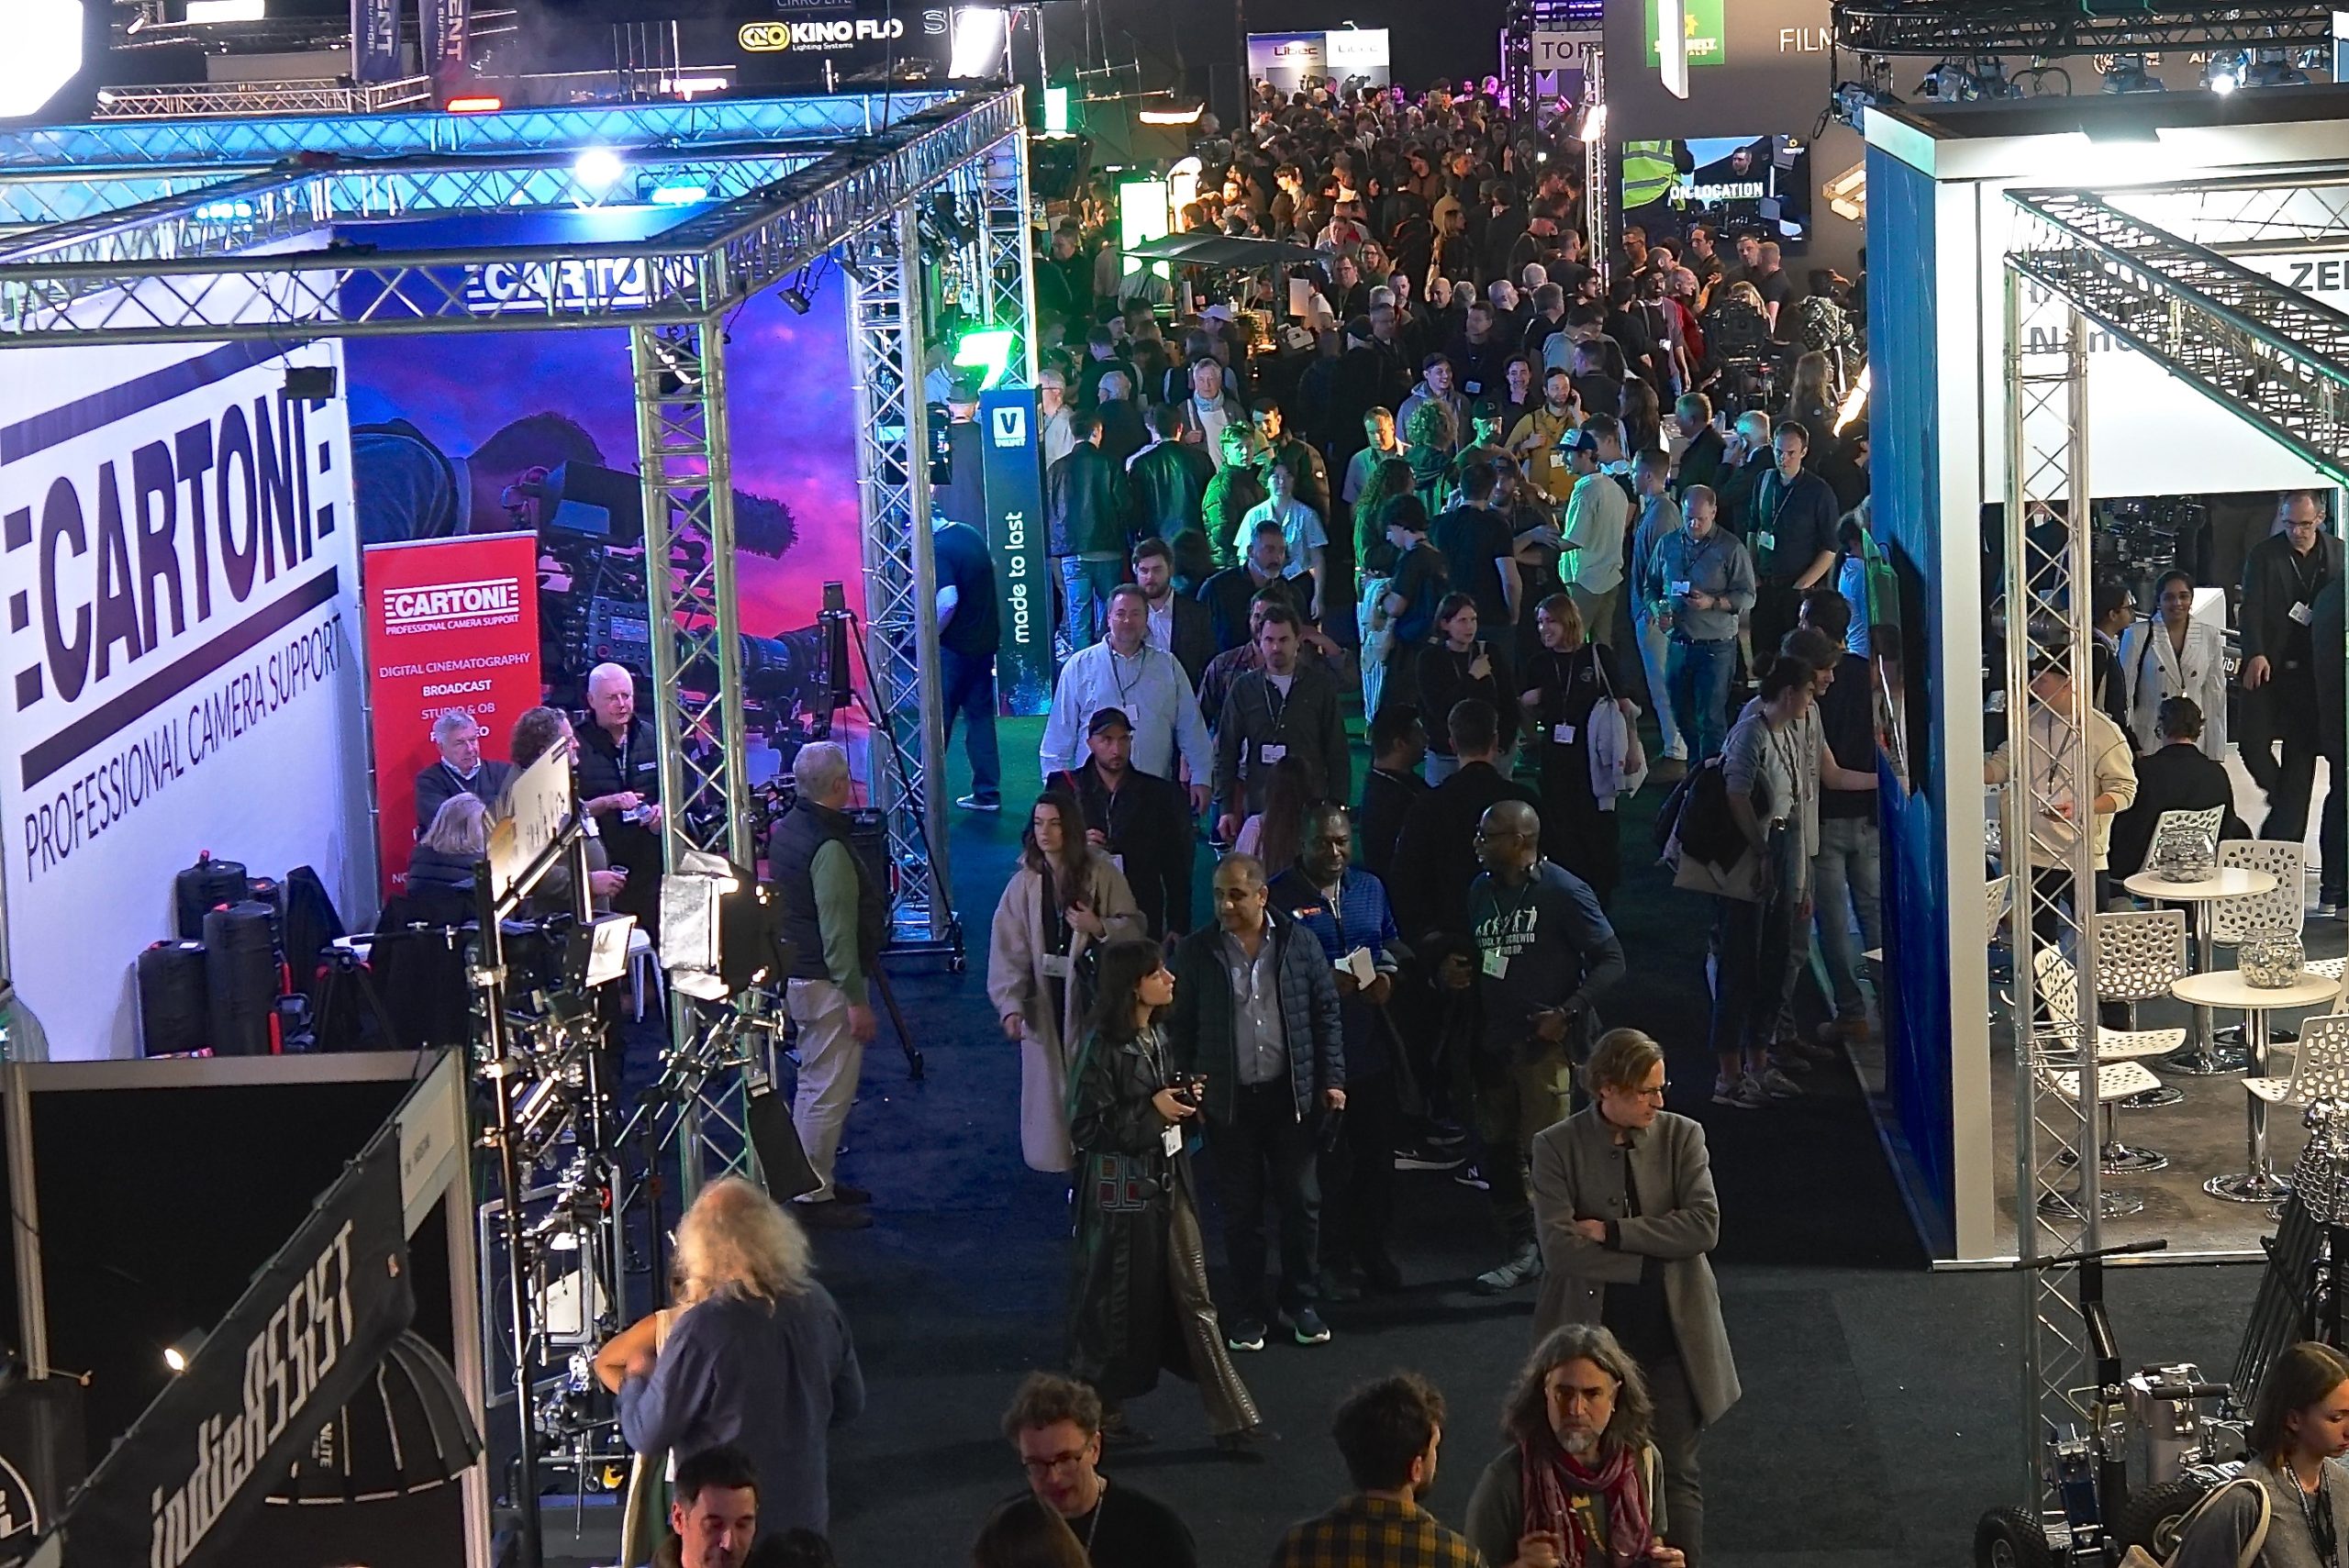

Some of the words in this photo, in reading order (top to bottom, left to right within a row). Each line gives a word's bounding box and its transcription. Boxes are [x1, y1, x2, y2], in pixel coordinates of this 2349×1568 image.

[792, 21, 853, 43] KINO
[856, 18, 904, 41] FLO
[792, 44, 822, 52] Lighting
[823, 42, 853, 50] Systems
[1274, 46, 1319, 57] Libec
[1670, 186, 1690, 200] ON
[1693, 183, 1764, 200] LOCATION
[1005, 511, 1025, 550] last
[40, 389, 313, 703] CARTONI
[1008, 556, 1026, 578] to
[395, 585, 508, 617] CARTONI
[1008, 584, 1030, 643] made
[386, 623, 447, 636] PROFESSIONAL
[448, 618, 483, 629] CAMERA
[483, 615, 518, 626] SUPPORT
[379, 663, 424, 678] DIGITAL
[425, 652, 531, 673] CINEMATOGRAPHY
[422, 680, 492, 697] BROADCAST
[467, 705, 476, 715] &
[477, 702, 495, 714] OB
[25, 718, 184, 884] PROFESSIONAL
[188, 664, 267, 766] CAMERA
[269, 613, 342, 712] SUPPORT
